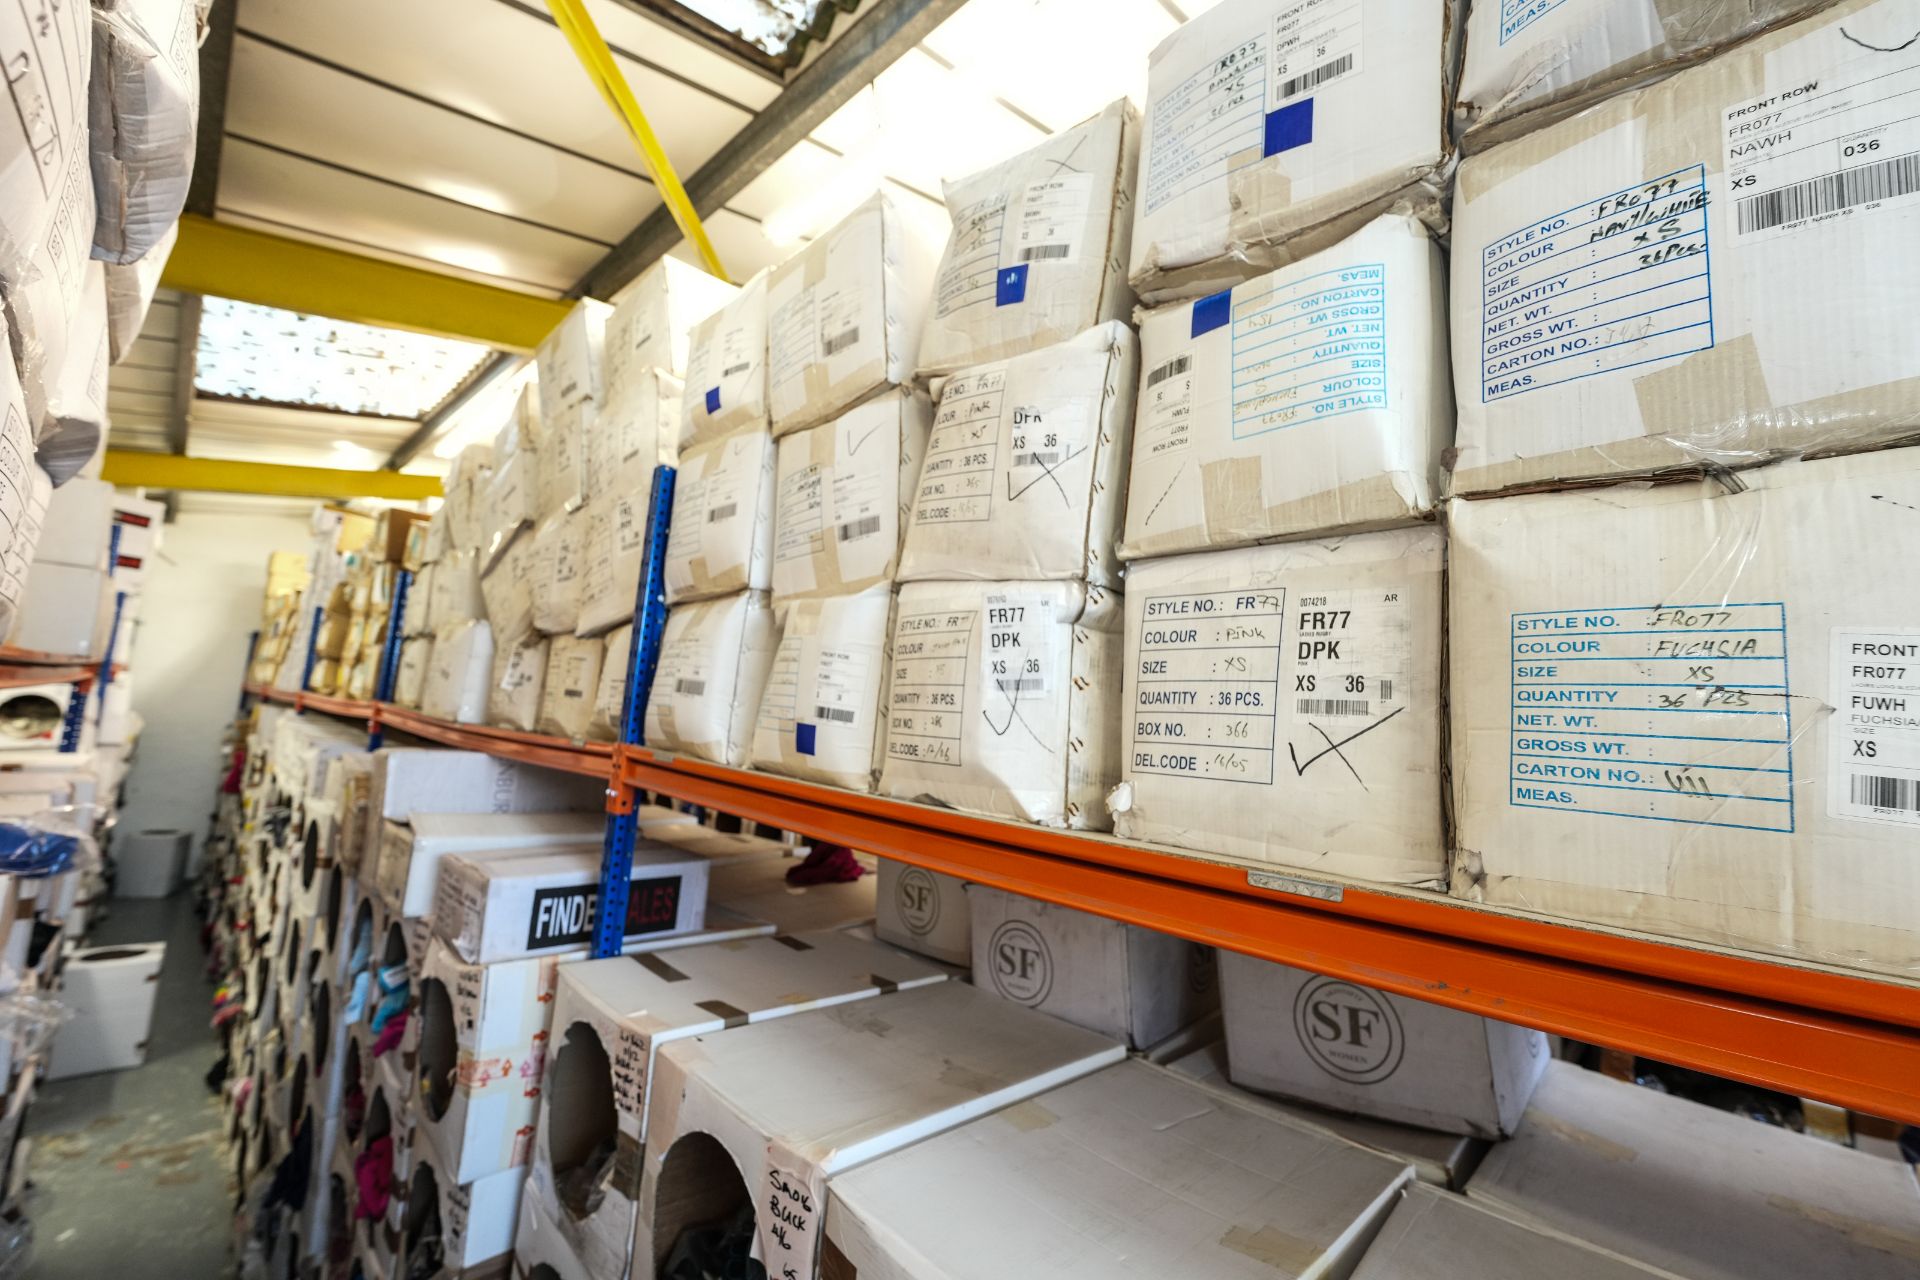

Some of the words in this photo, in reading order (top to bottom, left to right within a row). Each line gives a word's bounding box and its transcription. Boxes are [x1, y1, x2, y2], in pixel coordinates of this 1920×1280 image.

[1505, 0, 1551, 36] MEAS.
[1728, 97, 1777, 121] FRONT
[1781, 81, 1819, 102] ROW
[1729, 112, 1783, 139] FR077
[1730, 130, 1792, 160] NAWH
[1843, 139, 1881, 157] 036
[1731, 175, 1757, 191] XS
[1487, 229, 1536, 259] STYLE
[1541, 218, 1570, 235] NO.
[1487, 243, 1555, 278] COLOUR
[1338, 270, 1380, 283] MEAS.
[1322, 287, 1380, 304] CARTON
[1487, 276, 1520, 298] SIZE
[1487, 278, 1569, 317] QUANTITY
[1331, 303, 1380, 322] GROSS
[1487, 318, 1520, 337] NET.
[1524, 304, 1553, 322] WT.
[1487, 330, 1544, 356] GROSS
[1550, 318, 1580, 335] WT.
[1312, 340, 1381, 360] QUANTITY
[1351, 359, 1381, 369] SIZE
[1487, 346, 1556, 376] CARTON
[1323, 375, 1382, 394] COLOUR
[1487, 374, 1537, 396] MEAS.
[1338, 394, 1382, 410] STYLE
[1012, 435, 1026, 450] XS
[1044, 433, 1058, 448] 36
[1384, 593, 1399, 603] AR
[989, 607, 1025, 624] FR77
[1148, 602, 1190, 616] STYLE
[901, 619, 924, 632] STYLE
[1299, 611, 1352, 631] FR77
[1516, 616, 1579, 631] STYLE
[1584, 615, 1621, 629] NO.
[991, 631, 1021, 648] DPK
[1144, 629, 1198, 645] COLOUR
[1298, 640, 1341, 661] DPK
[1516, 640, 1601, 655] COLOUR
[1653, 637, 1758, 659] FUCHSIA
[1851, 642, 1919, 658] FRONT
[991, 659, 1007, 675] XS
[1026, 658, 1041, 674] 36
[1142, 660, 1168, 675] SIZE
[1516, 665, 1558, 678] SIZE
[1683, 665, 1715, 683] XS
[1852, 665, 1907, 680] FR077
[1295, 674, 1317, 693] XS
[1345, 674, 1366, 694] 36
[1139, 691, 1197, 706] QUANTITY
[1218, 692, 1232, 705] 36
[1234, 692, 1265, 708] PCS.
[1516, 690, 1619, 704] QUANTITY
[1657, 693, 1688, 709] 36
[1852, 695, 1906, 712] FUWH
[1137, 723, 1162, 736] BOX
[1164, 723, 1187, 738] NO.
[1516, 714, 1557, 728] NET.
[1563, 715, 1598, 729] WT.
[1853, 726, 1876, 735] SIZE
[1516, 738, 1588, 754] GROSS
[1592, 742, 1630, 757] WT.
[1852, 739, 1878, 758] XS
[1135, 753, 1198, 772] DEL.CODE
[1516, 762, 1601, 781] CARTON
[1607, 767, 1647, 784] NO.
[1516, 786, 1579, 805] MEAS.
[901, 883, 932, 916] SF
[535, 894, 596, 939] FINDE
[626, 885, 674, 924] ALES
[998, 942, 1041, 980] SF
[1311, 1000, 1380, 1049] SF
[1328, 1050, 1368, 1064] WOMEN
